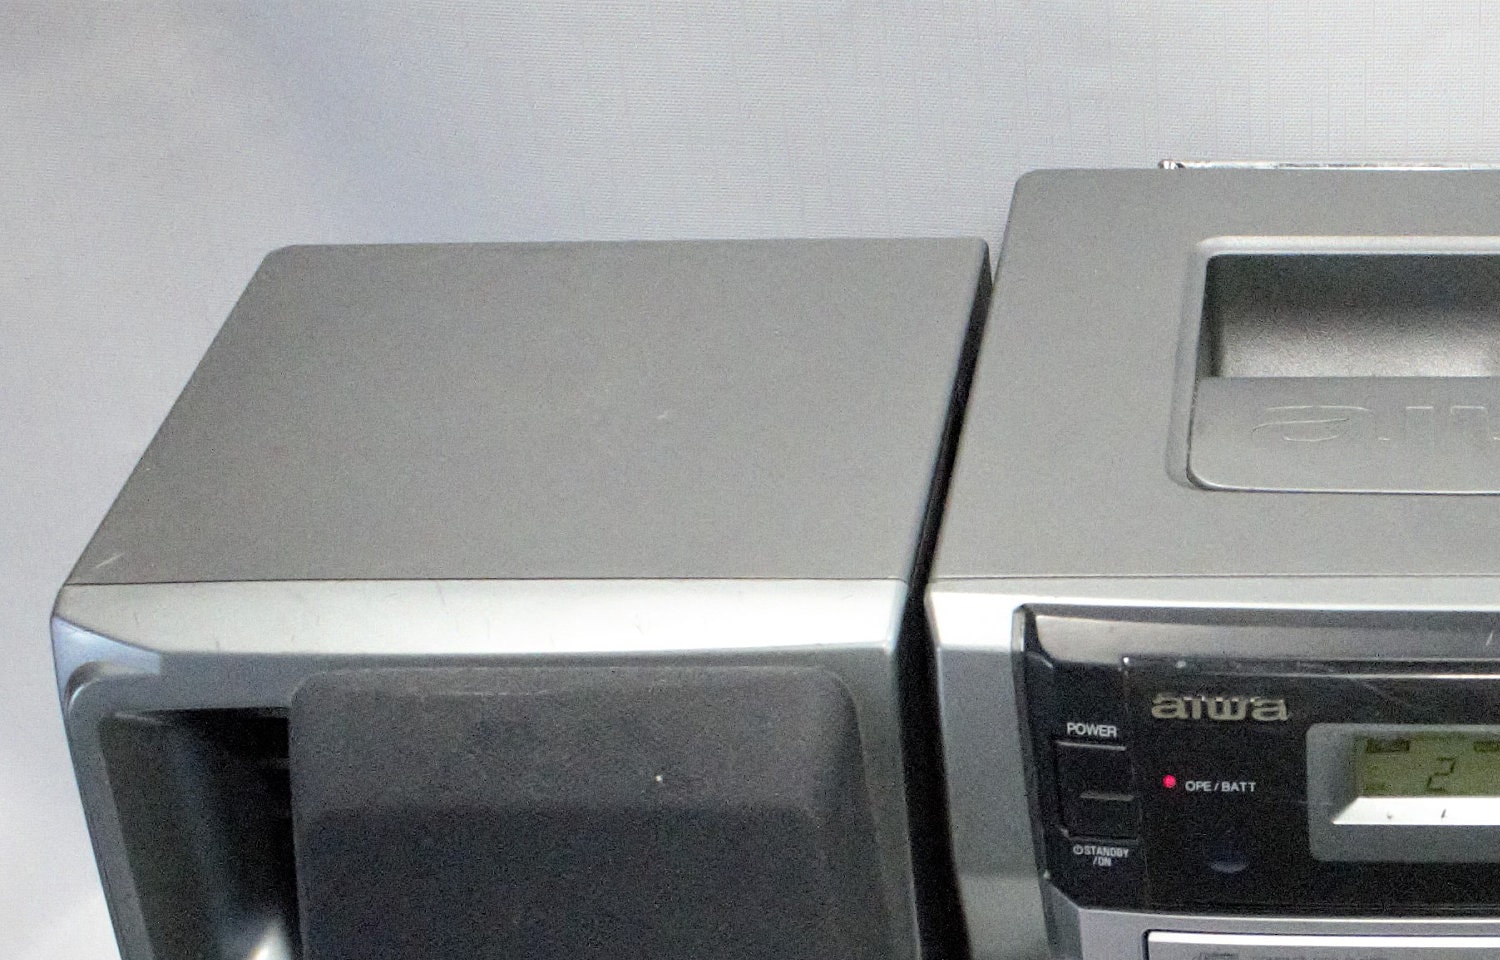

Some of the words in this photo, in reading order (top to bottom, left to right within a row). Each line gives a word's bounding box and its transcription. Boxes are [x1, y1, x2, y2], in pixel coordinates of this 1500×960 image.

[1151, 692, 1290, 723] aiwa
[1066, 722, 1118, 738] POWER
[1084, 845, 1129, 859] STANDBY
